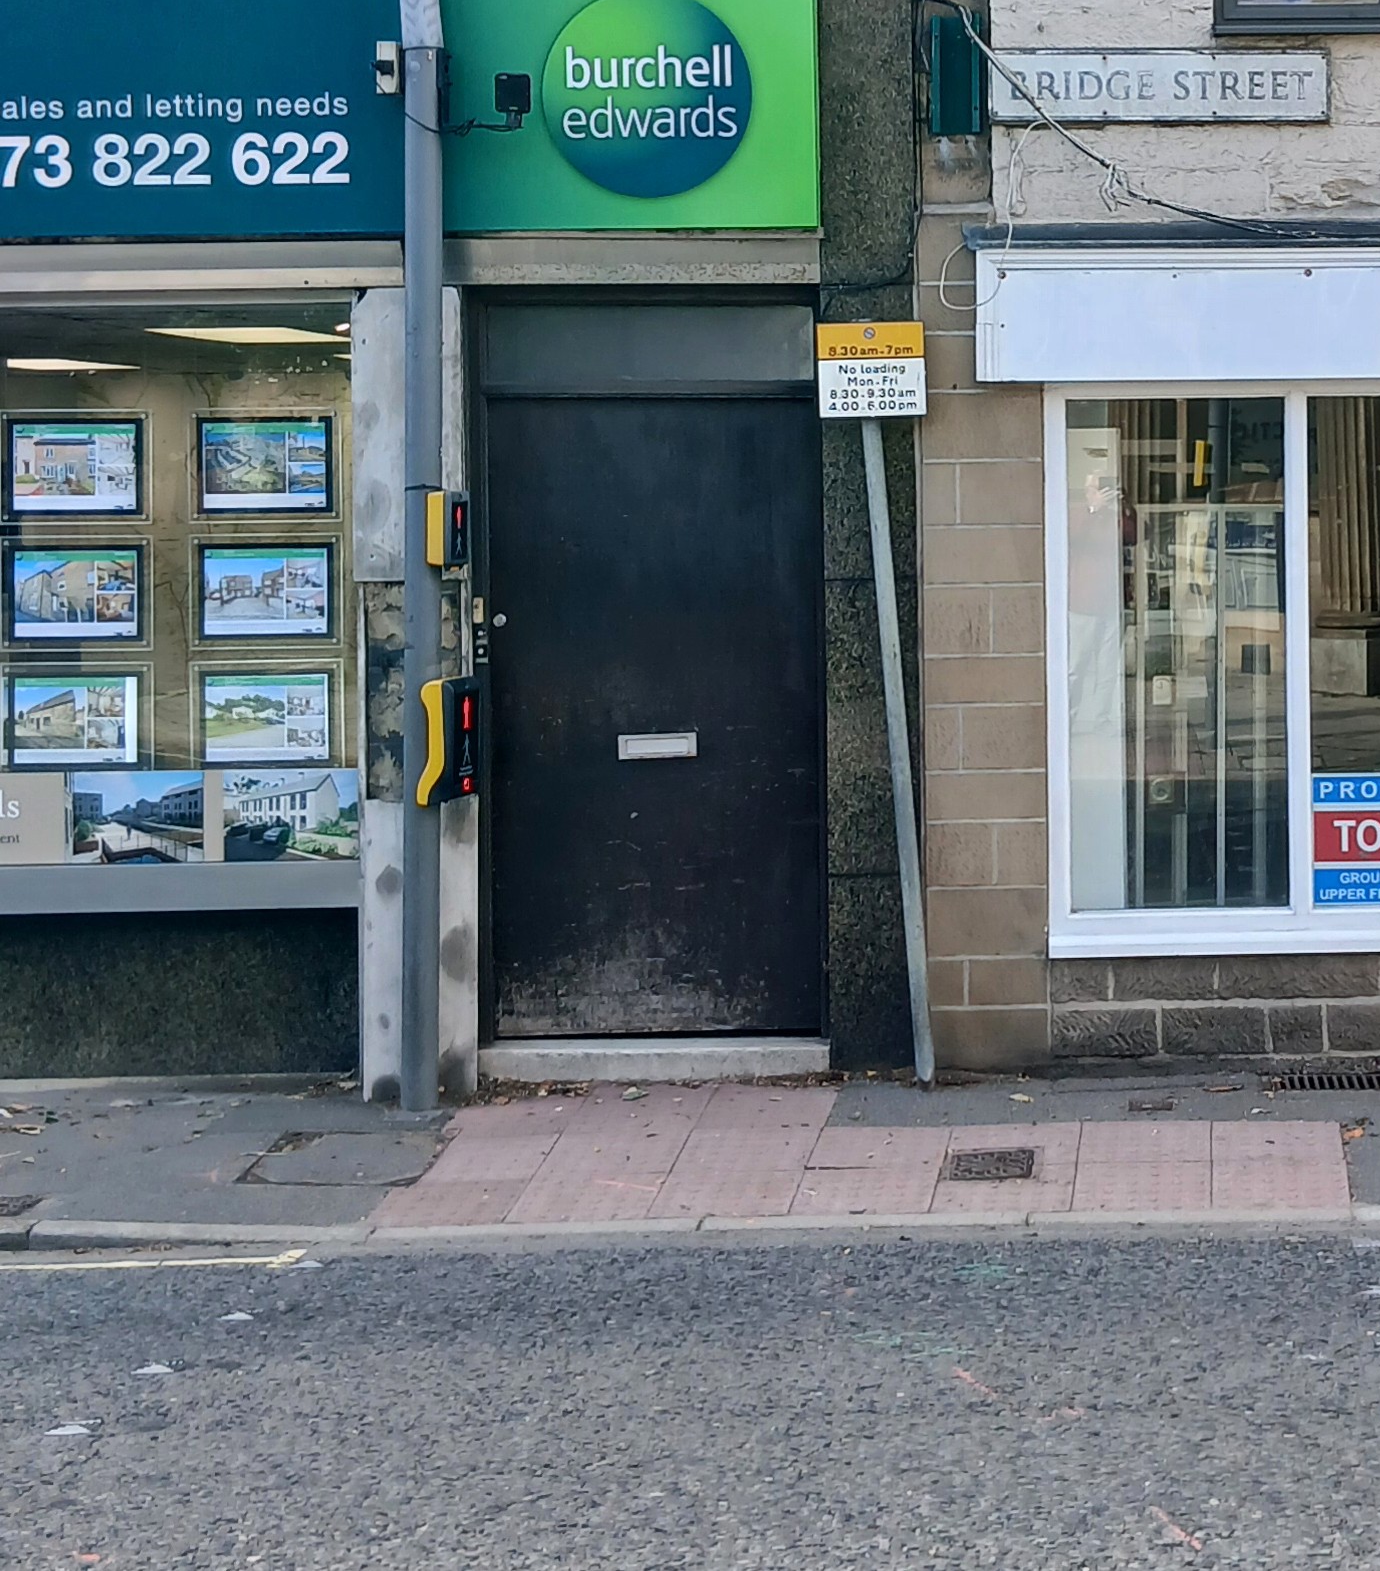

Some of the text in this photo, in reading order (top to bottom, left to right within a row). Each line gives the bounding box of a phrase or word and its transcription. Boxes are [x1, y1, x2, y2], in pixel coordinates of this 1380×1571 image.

[565, 44, 732, 88] burchell
[1009, 69, 1314, 103] BRIDGE STREET
[76, 94, 133, 119] and
[146, 93, 243, 123] letting
[256, 91, 349, 117] needs
[562, 95, 737, 139] edwards
[92, 133, 211, 187] 822
[231, 131, 350, 186] 622
[838, 363, 906, 375] No loading
[1320, 888, 1368, 900] UPPER
